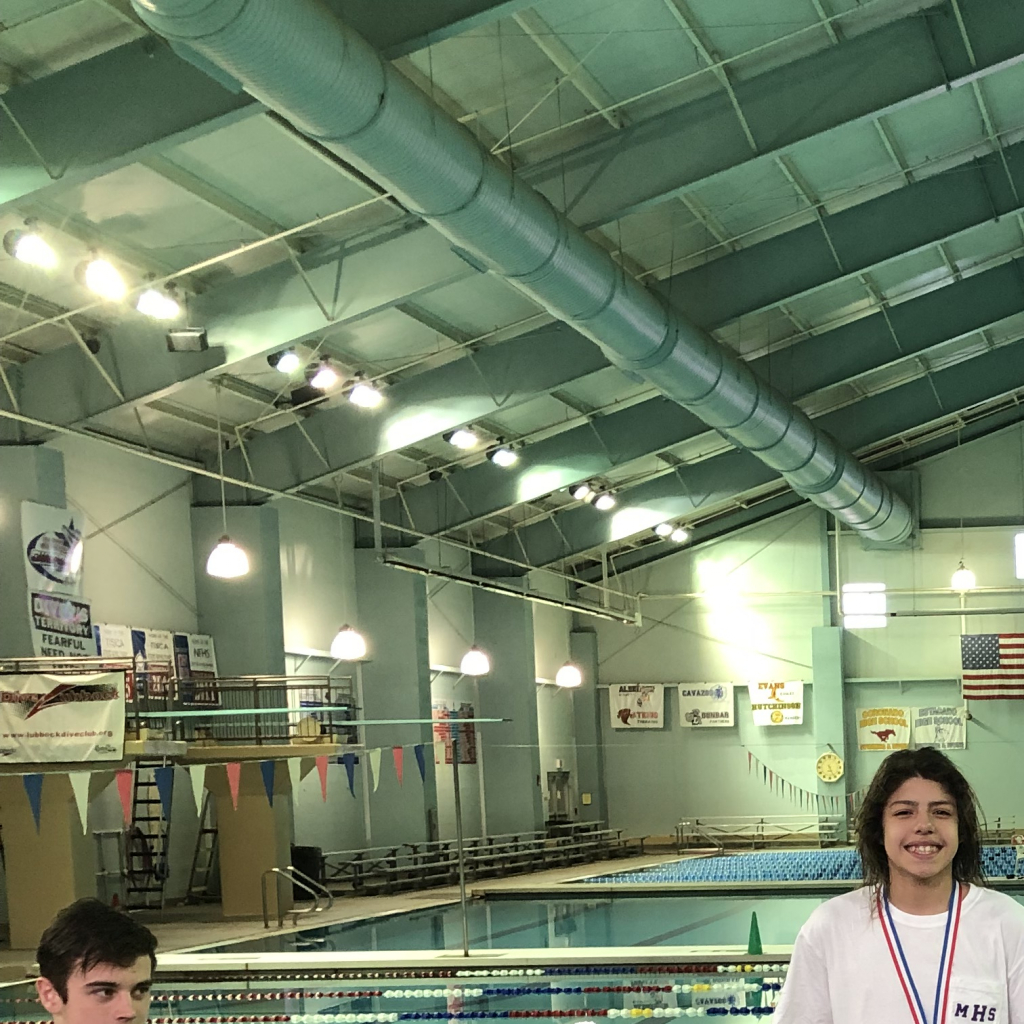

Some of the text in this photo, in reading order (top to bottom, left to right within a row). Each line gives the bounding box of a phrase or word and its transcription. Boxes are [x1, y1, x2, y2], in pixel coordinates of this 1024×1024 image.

[35, 615, 89, 636] TERRITORY
[42, 634, 86, 650] FEARFUL
[954, 1003, 997, 1022] MHS
